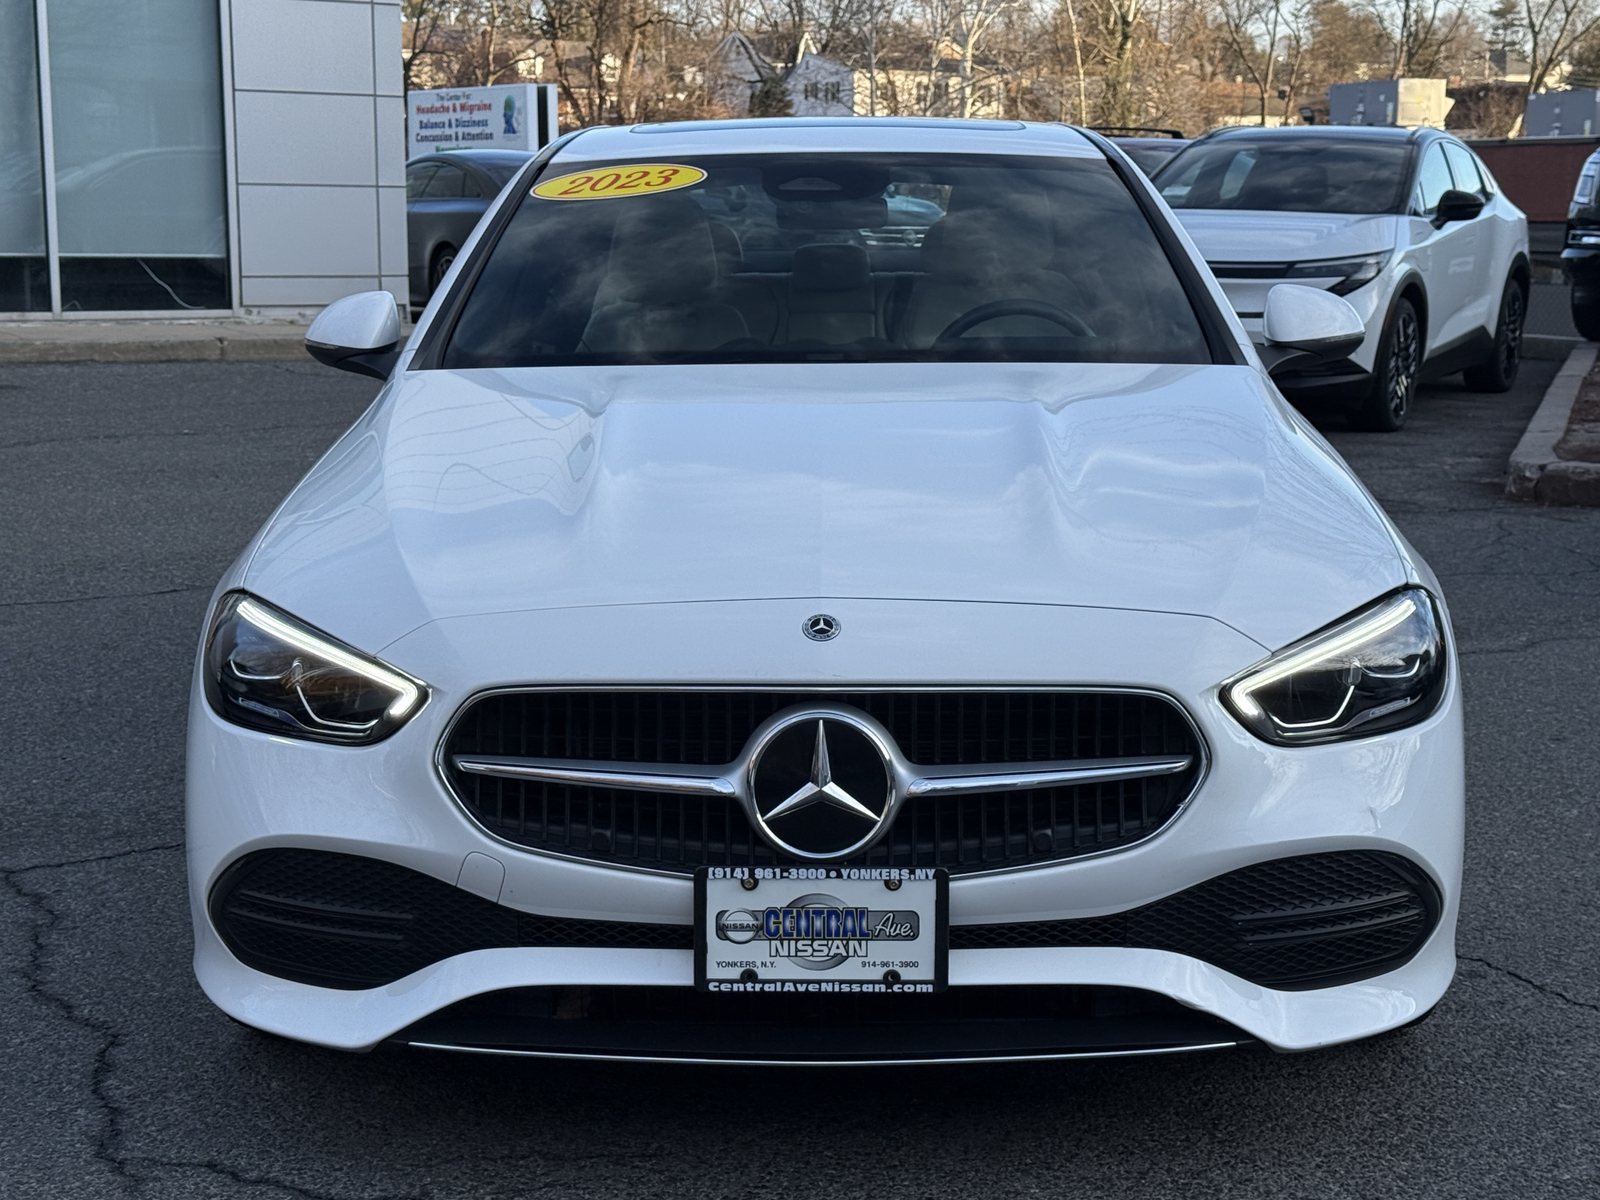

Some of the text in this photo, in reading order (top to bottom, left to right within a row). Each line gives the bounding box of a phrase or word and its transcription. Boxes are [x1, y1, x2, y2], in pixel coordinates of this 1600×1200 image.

[416, 100, 492, 115] Headache & Migraine
[419, 117, 489, 130] Balance & Dizziness
[416, 131, 453, 143] Concussion
[454, 131, 460, 142] &
[461, 130, 494, 142] Attention
[557, 169, 680, 196] 2023
[708, 867, 750, 880] (914)
[754, 867, 825, 880] 961-3900
[722, 922, 758, 931] NISSAN
[763, 907, 915, 939] CENTRAL Ave.
[769, 940, 868, 957] NISSAN
[715, 960, 777, 969] YONKERS, N.Y.
[861, 960, 919, 968] 914-961-3900
[708, 981, 933, 993] CentralAveNissan.com
